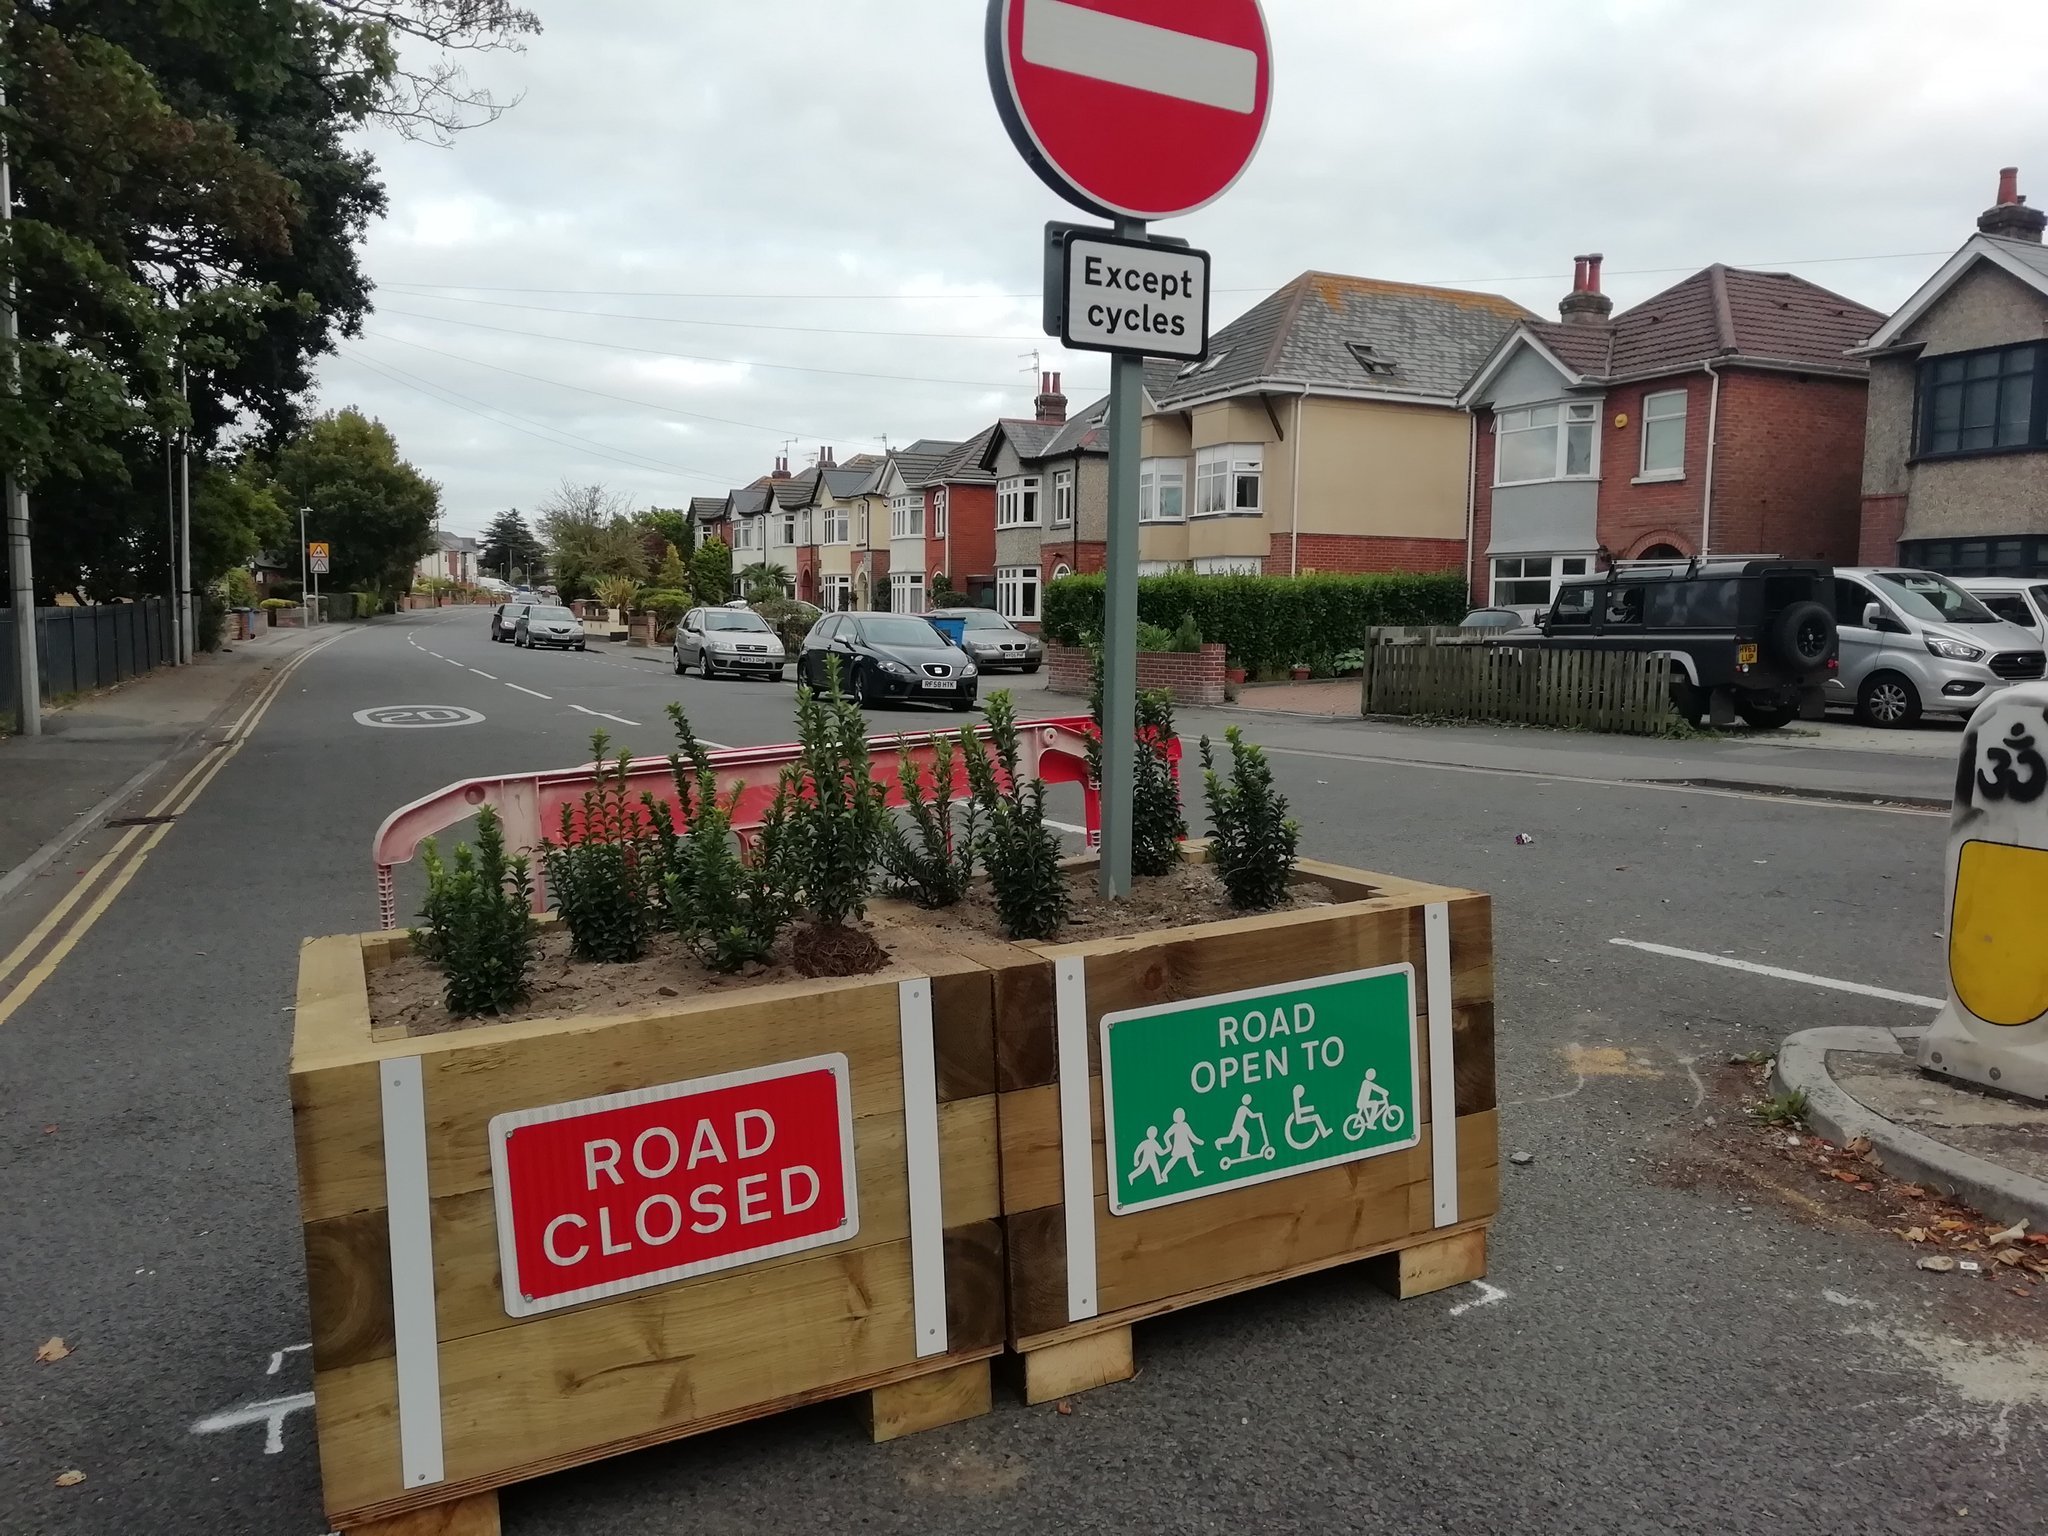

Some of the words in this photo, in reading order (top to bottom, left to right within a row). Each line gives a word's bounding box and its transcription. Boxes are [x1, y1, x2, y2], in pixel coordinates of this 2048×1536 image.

[1085, 255, 1192, 301] Except
[1087, 303, 1185, 336] cycles
[375, 709, 461, 722] 20
[1218, 1002, 1316, 1048] ROAD
[1190, 1046, 1289, 1093] OPEN
[1300, 1036, 1345, 1071] TO
[583, 1108, 776, 1191] ROAD
[542, 1164, 821, 1266] CLOSED
